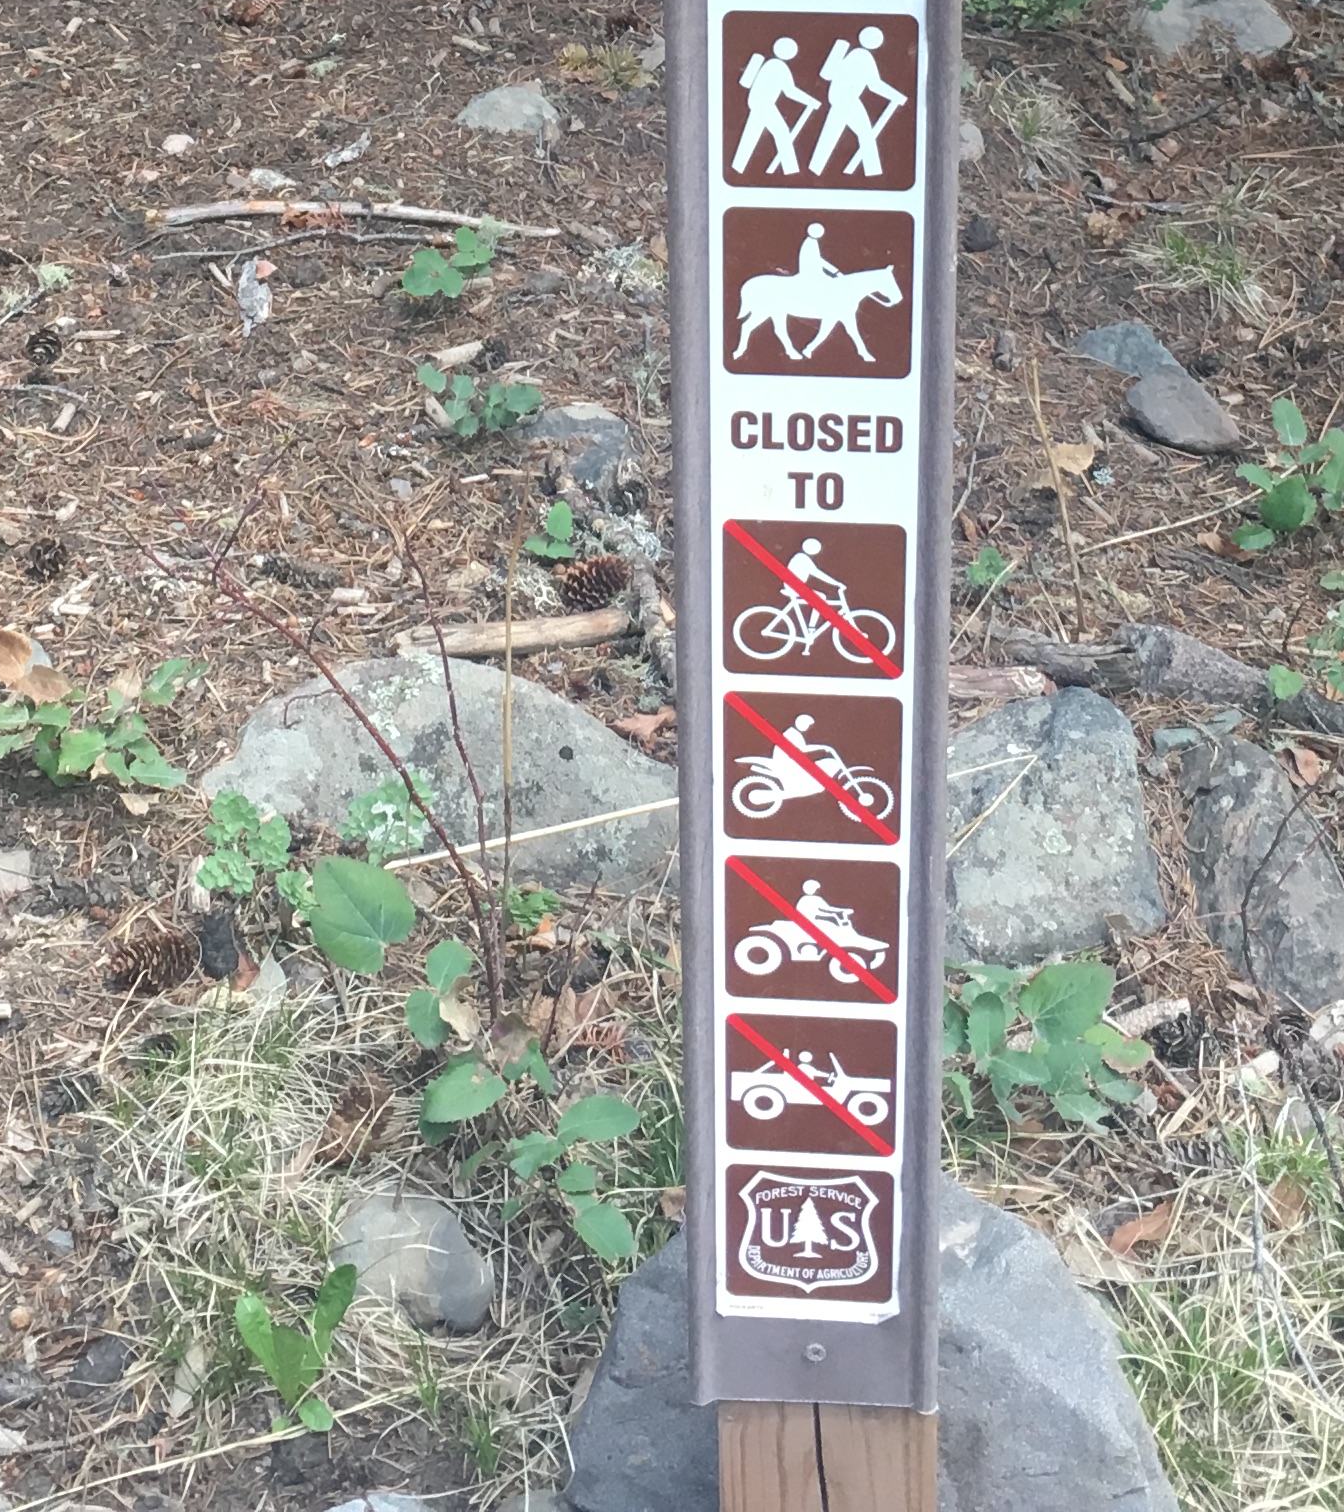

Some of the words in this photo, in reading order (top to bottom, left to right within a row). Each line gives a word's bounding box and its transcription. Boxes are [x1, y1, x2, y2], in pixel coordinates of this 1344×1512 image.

[730, 410, 903, 453] CLOSED
[787, 472, 844, 510] TO
[755, 1186, 805, 1205] FOREST
[809, 1186, 862, 1210] SERVICE
[747, 1245, 800, 1278] DEPARTMENT
[802, 1268, 816, 1279] OF
[816, 1250, 869, 1280] AGRICULTURE
